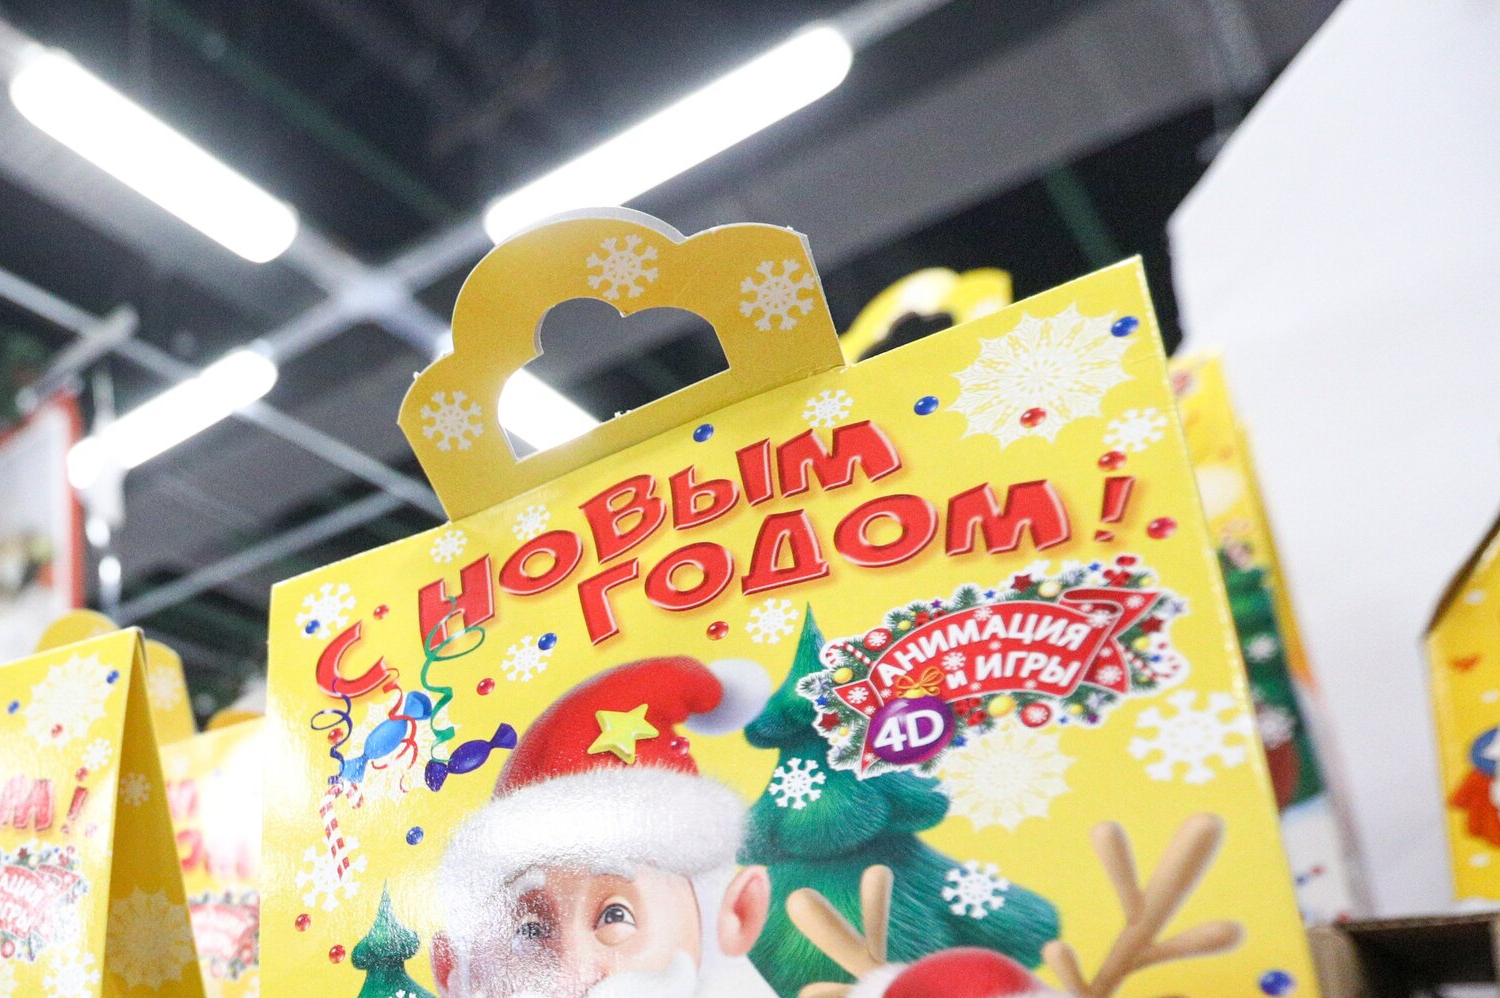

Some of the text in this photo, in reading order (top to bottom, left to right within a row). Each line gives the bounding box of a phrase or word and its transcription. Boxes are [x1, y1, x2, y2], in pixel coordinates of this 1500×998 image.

[316, 420, 903, 699] С НОВЫМ
[876, 612, 1091, 687] АНИМАЦИЯ
[975, 651, 1082, 687] ИГРЫ
[874, 708, 945, 752] 4D
